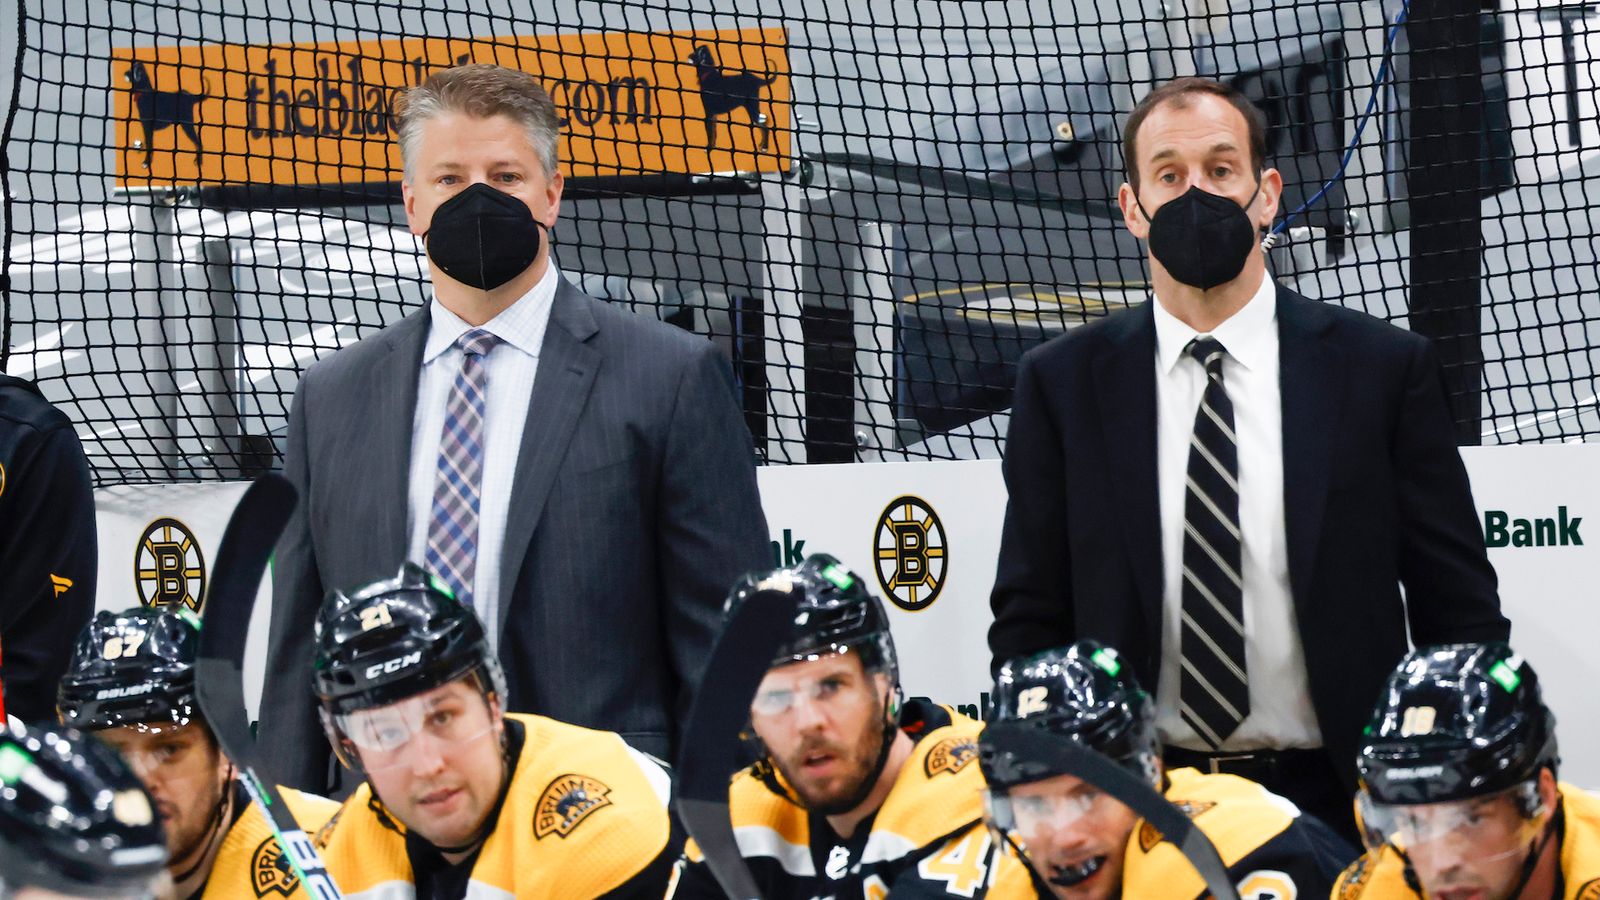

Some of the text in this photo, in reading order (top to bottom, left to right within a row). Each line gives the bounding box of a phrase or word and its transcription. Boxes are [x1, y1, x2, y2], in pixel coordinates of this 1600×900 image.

[245, 52, 653, 140] theblaccom
[1484, 505, 1584, 548] Bank
[152, 541, 188, 605] B
[892, 520, 929, 586] B
[359, 603, 393, 631] 21
[365, 650, 422, 680] CCM
[1017, 686, 1048, 719] 12
